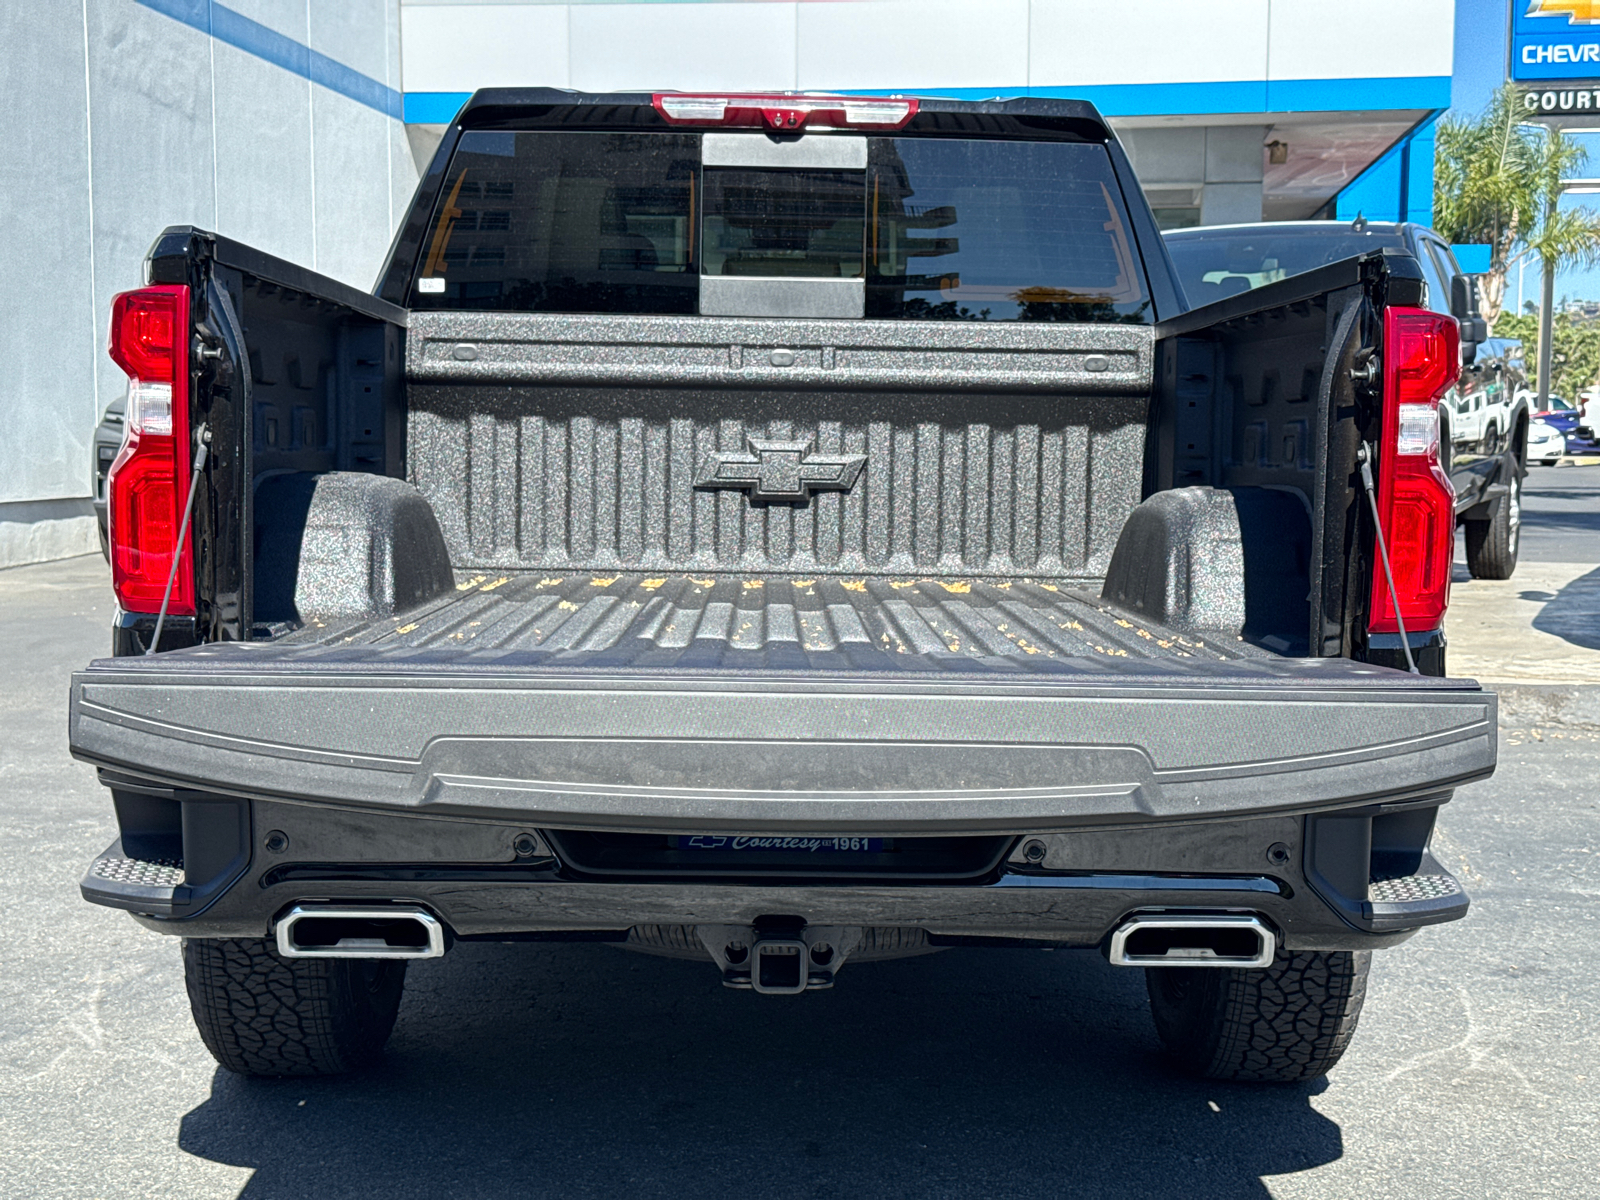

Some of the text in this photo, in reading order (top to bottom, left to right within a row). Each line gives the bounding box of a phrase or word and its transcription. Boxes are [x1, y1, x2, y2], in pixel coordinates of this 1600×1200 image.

[1522, 44, 1600, 64] CHEVR
[732, 836, 821, 852] Courtesy
[832, 837, 868, 851] 1961
